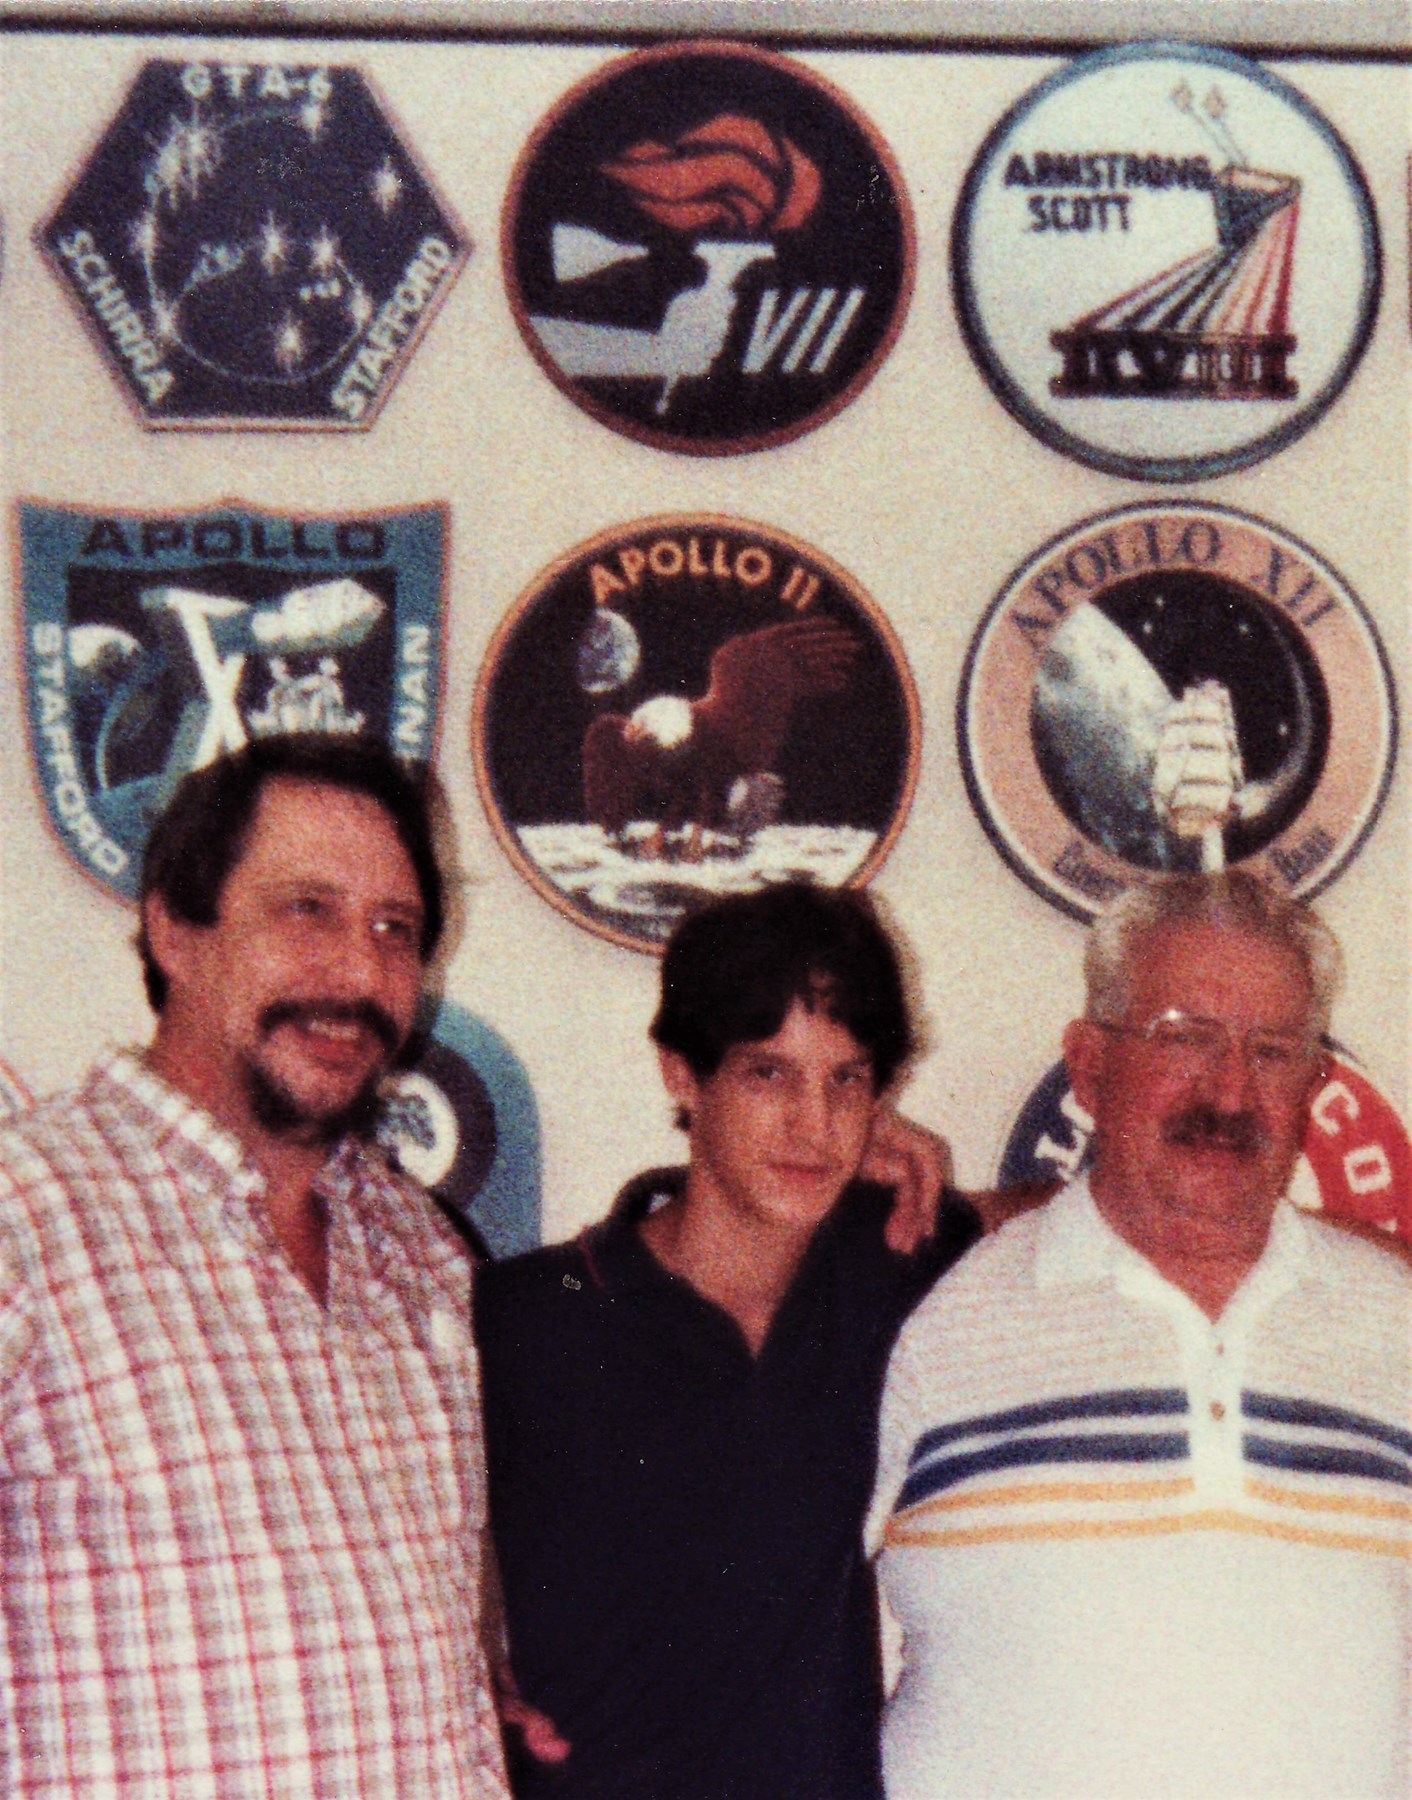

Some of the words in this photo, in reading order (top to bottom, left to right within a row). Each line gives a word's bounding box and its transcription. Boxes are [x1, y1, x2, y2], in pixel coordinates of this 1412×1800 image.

[181, 66, 333, 99] GTA-6
[1004, 151, 1215, 190] ARMSTRONG
[1027, 193, 1131, 233] SCOTT
[61, 230, 174, 403] SCHIRRA
[330, 239, 451, 421] STAFFORD
[82, 520, 386, 558] APOLLO
[590, 538, 773, 604] APOLLO
[1010, 520, 1221, 642] APOLLO
[32, 621, 128, 875] STAFFORD
